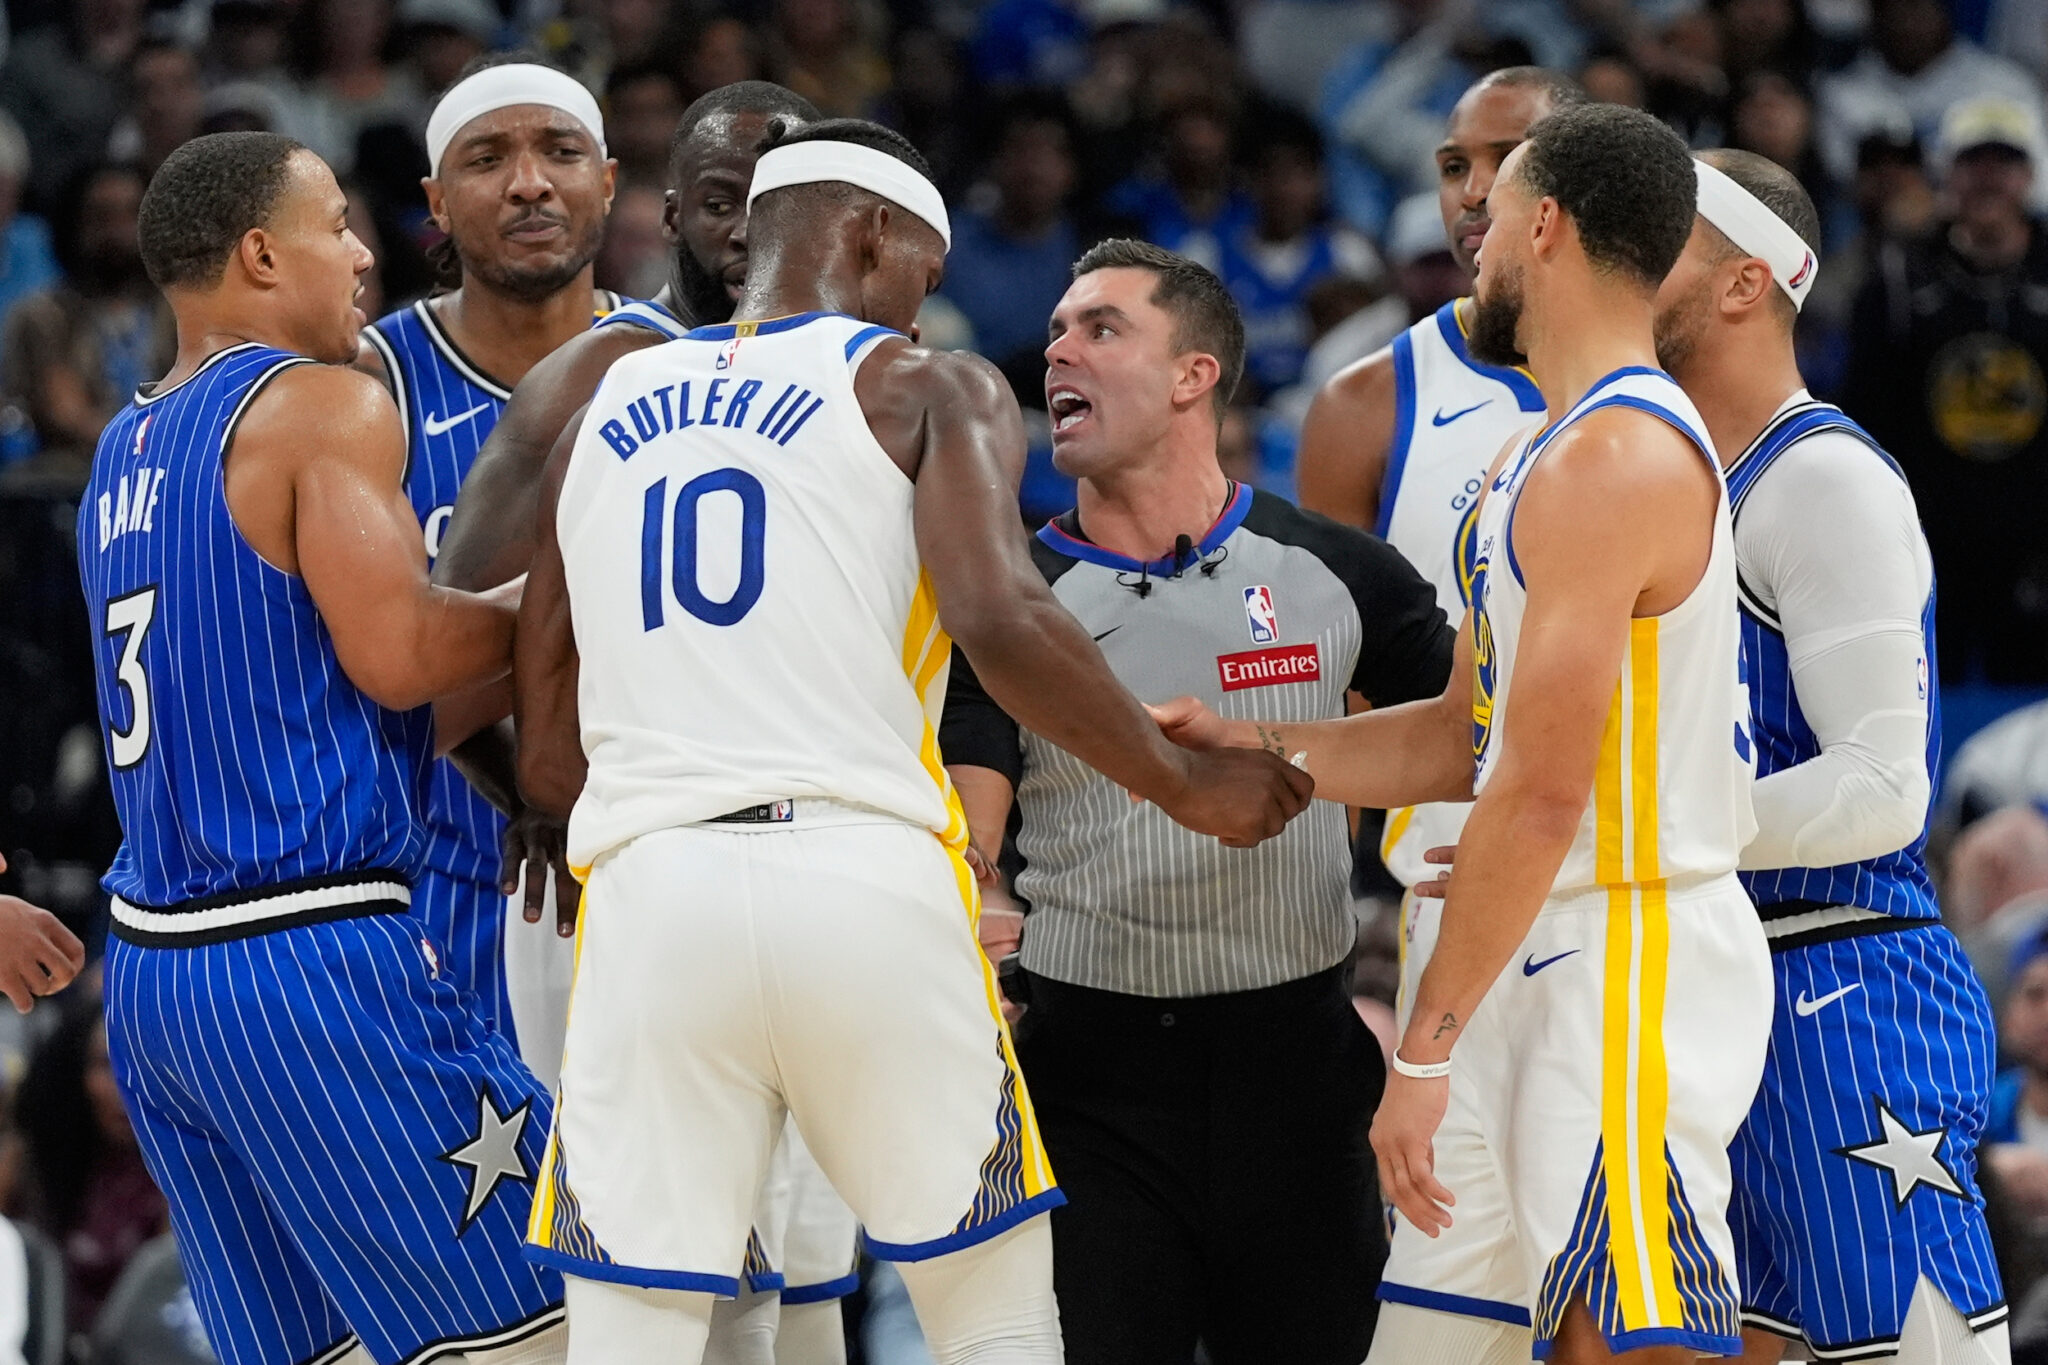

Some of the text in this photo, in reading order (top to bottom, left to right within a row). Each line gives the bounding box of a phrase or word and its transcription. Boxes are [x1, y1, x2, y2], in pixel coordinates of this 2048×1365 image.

[599, 378, 824, 462] BUTLER III
[98, 468, 165, 553] BANE
[1451, 469, 1487, 511] GO
[641, 468, 766, 632] 10
[106, 583, 157, 769] 3
[1222, 655, 1318, 683] Emirates
